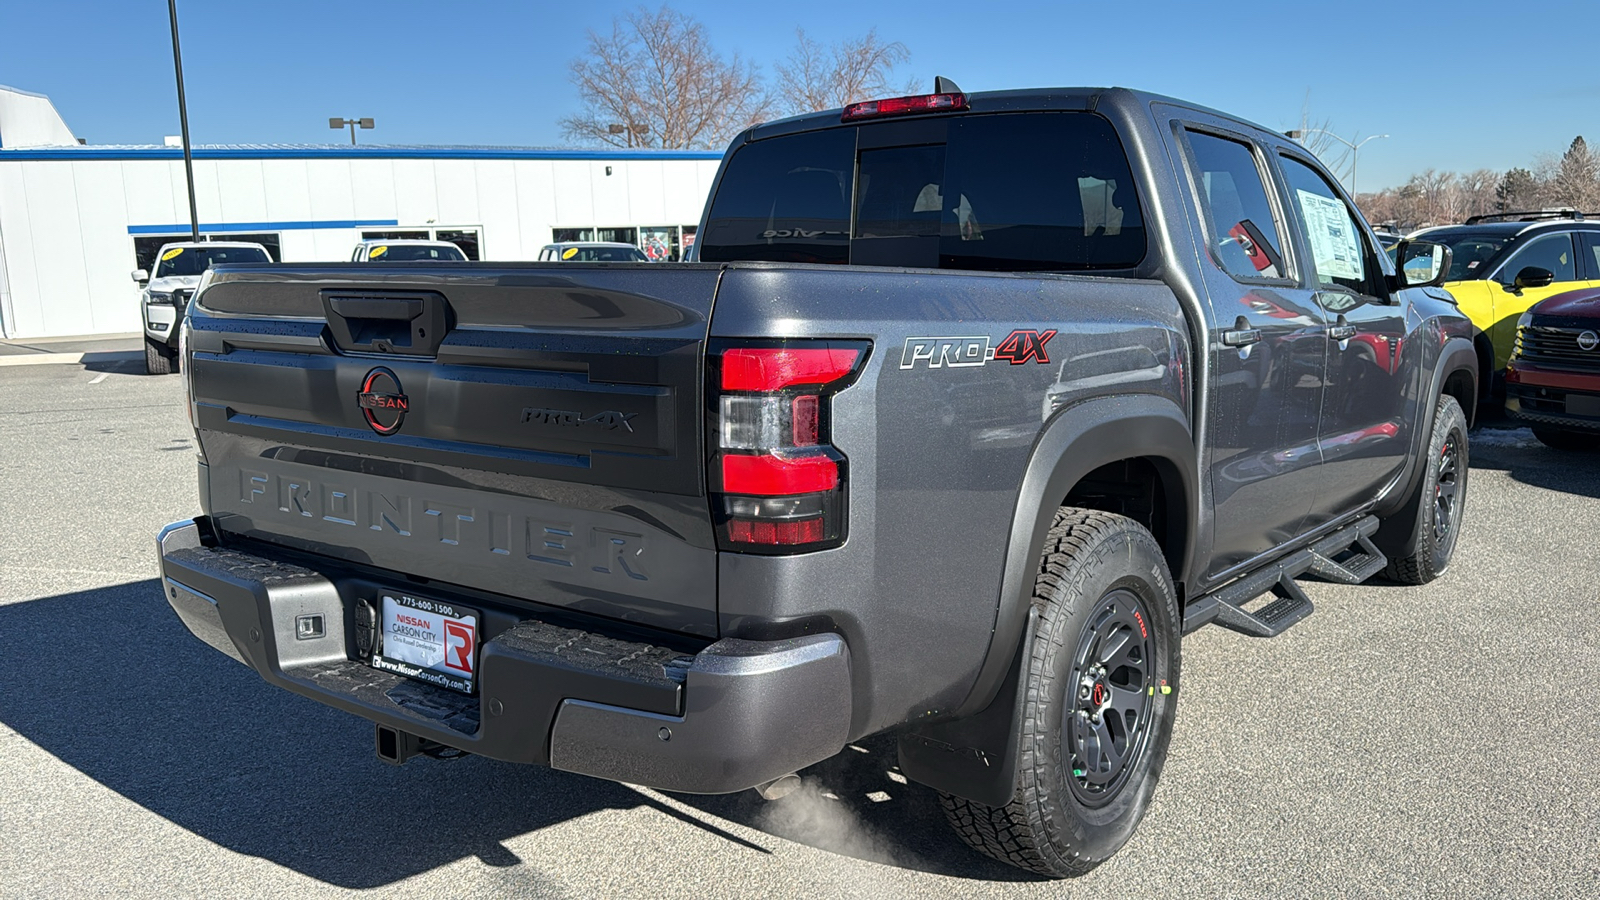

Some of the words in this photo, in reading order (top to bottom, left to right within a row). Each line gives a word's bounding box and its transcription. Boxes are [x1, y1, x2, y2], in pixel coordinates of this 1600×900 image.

[900, 329, 1058, 370] PRO-4X
[360, 394, 408, 409] NISSAN
[239, 468, 650, 582] FRONTIER
[402, 596, 453, 616] 775-600-1500
[396, 613, 431, 630] NISSAN
[392, 623, 421, 638] CARSON
[421, 630, 437, 642] CITY
[381, 660, 464, 689] www.NissanCarsonCity.com
